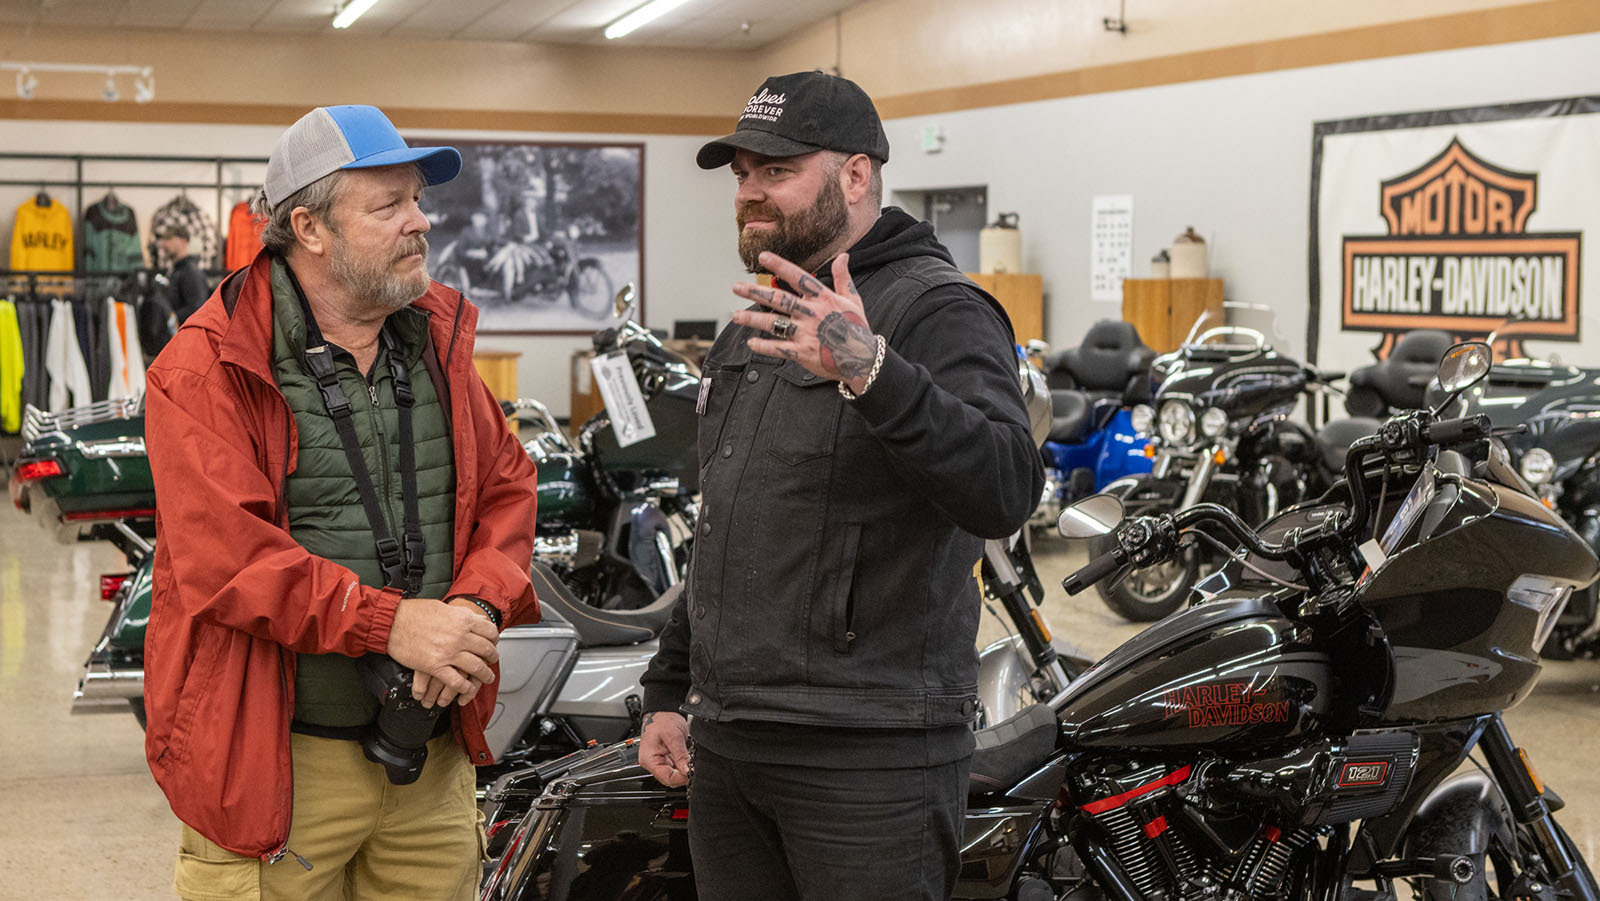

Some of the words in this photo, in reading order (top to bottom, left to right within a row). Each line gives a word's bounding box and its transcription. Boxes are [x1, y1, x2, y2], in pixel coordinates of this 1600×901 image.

[748, 87, 787, 105] olves
[1400, 163, 1514, 235] MOTOR
[1352, 255, 1563, 320] HARLEY-DAVIDSON
[1188, 701, 1290, 728] DAVIDSON
[1348, 765, 1380, 779] 121
